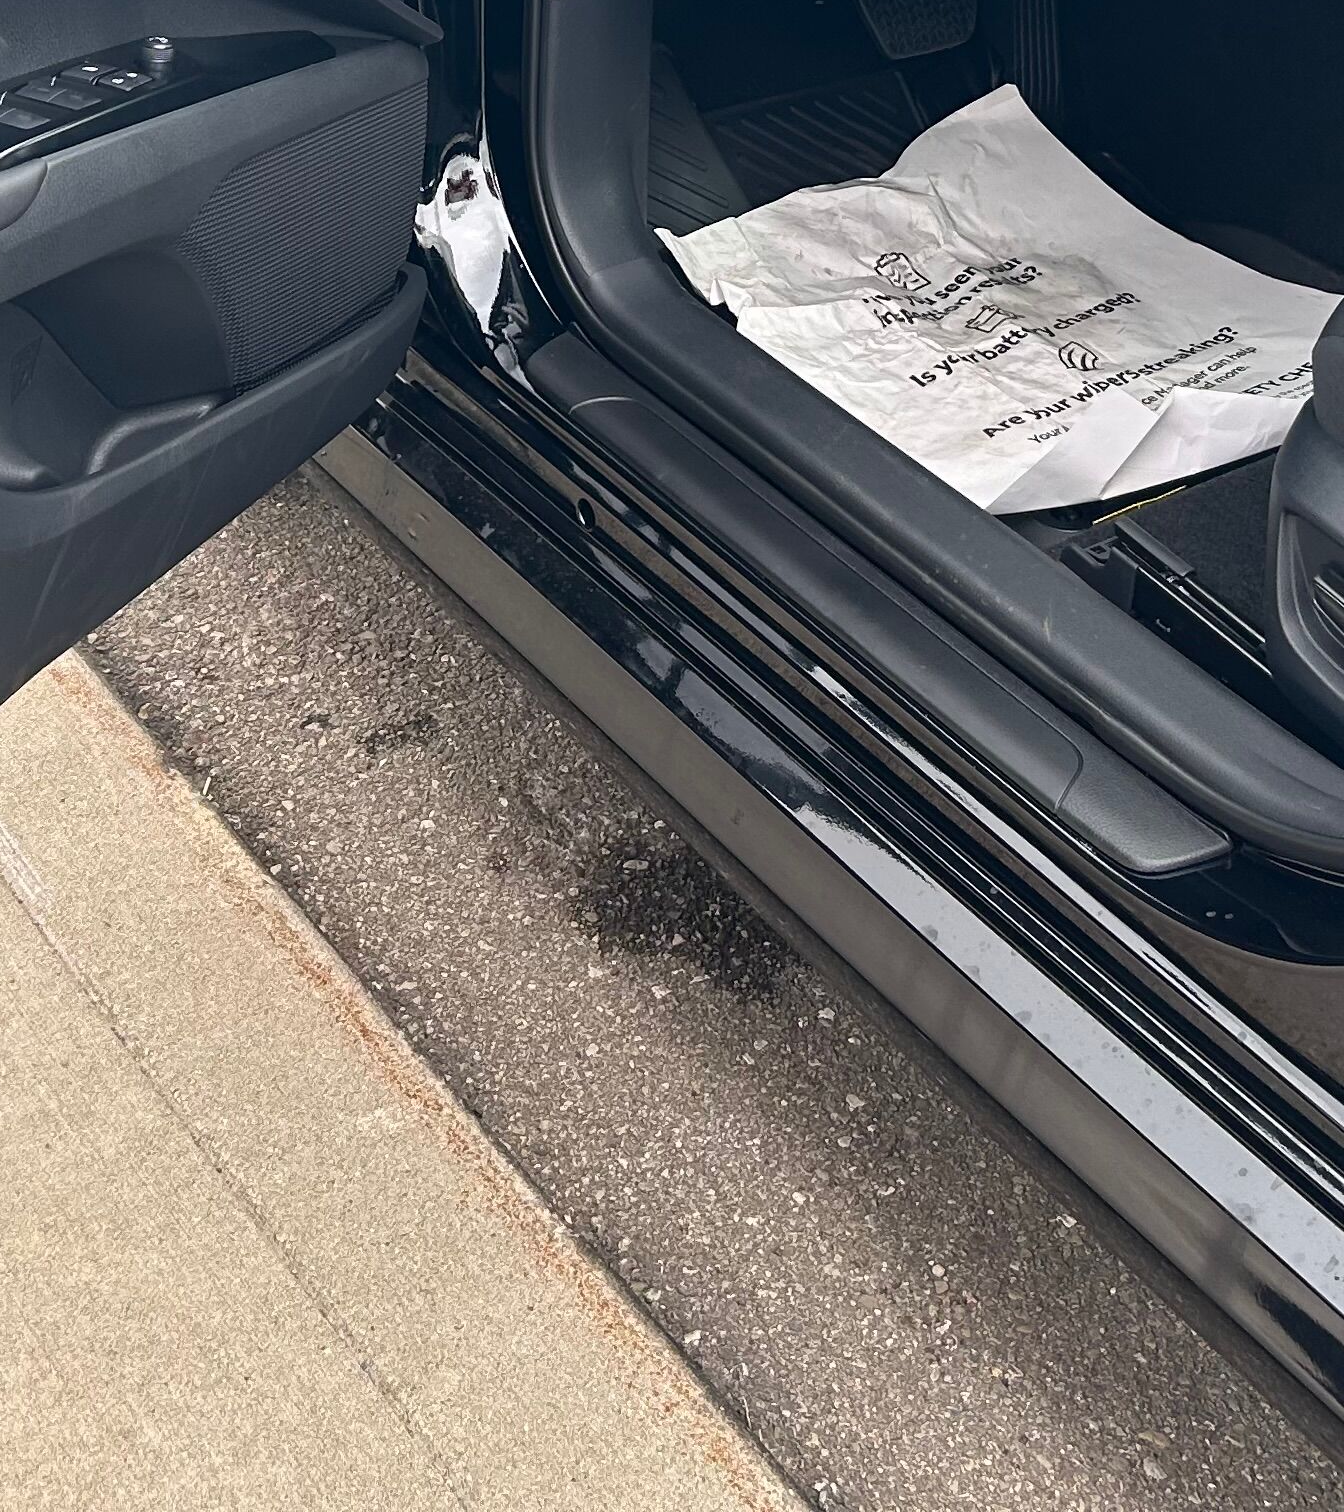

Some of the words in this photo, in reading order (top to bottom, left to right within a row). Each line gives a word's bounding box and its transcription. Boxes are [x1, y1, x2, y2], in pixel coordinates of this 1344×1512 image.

[934, 265, 980, 300] seen
[909, 371, 938, 388] Is
[1053, 292, 1142, 331] charged?
[982, 413, 1026, 439] Are
[1137, 326, 1239, 376] streaking?
[1027, 425, 1062, 445] Your
[1207, 355, 1232, 373] can
[1230, 345, 1258, 360] help
